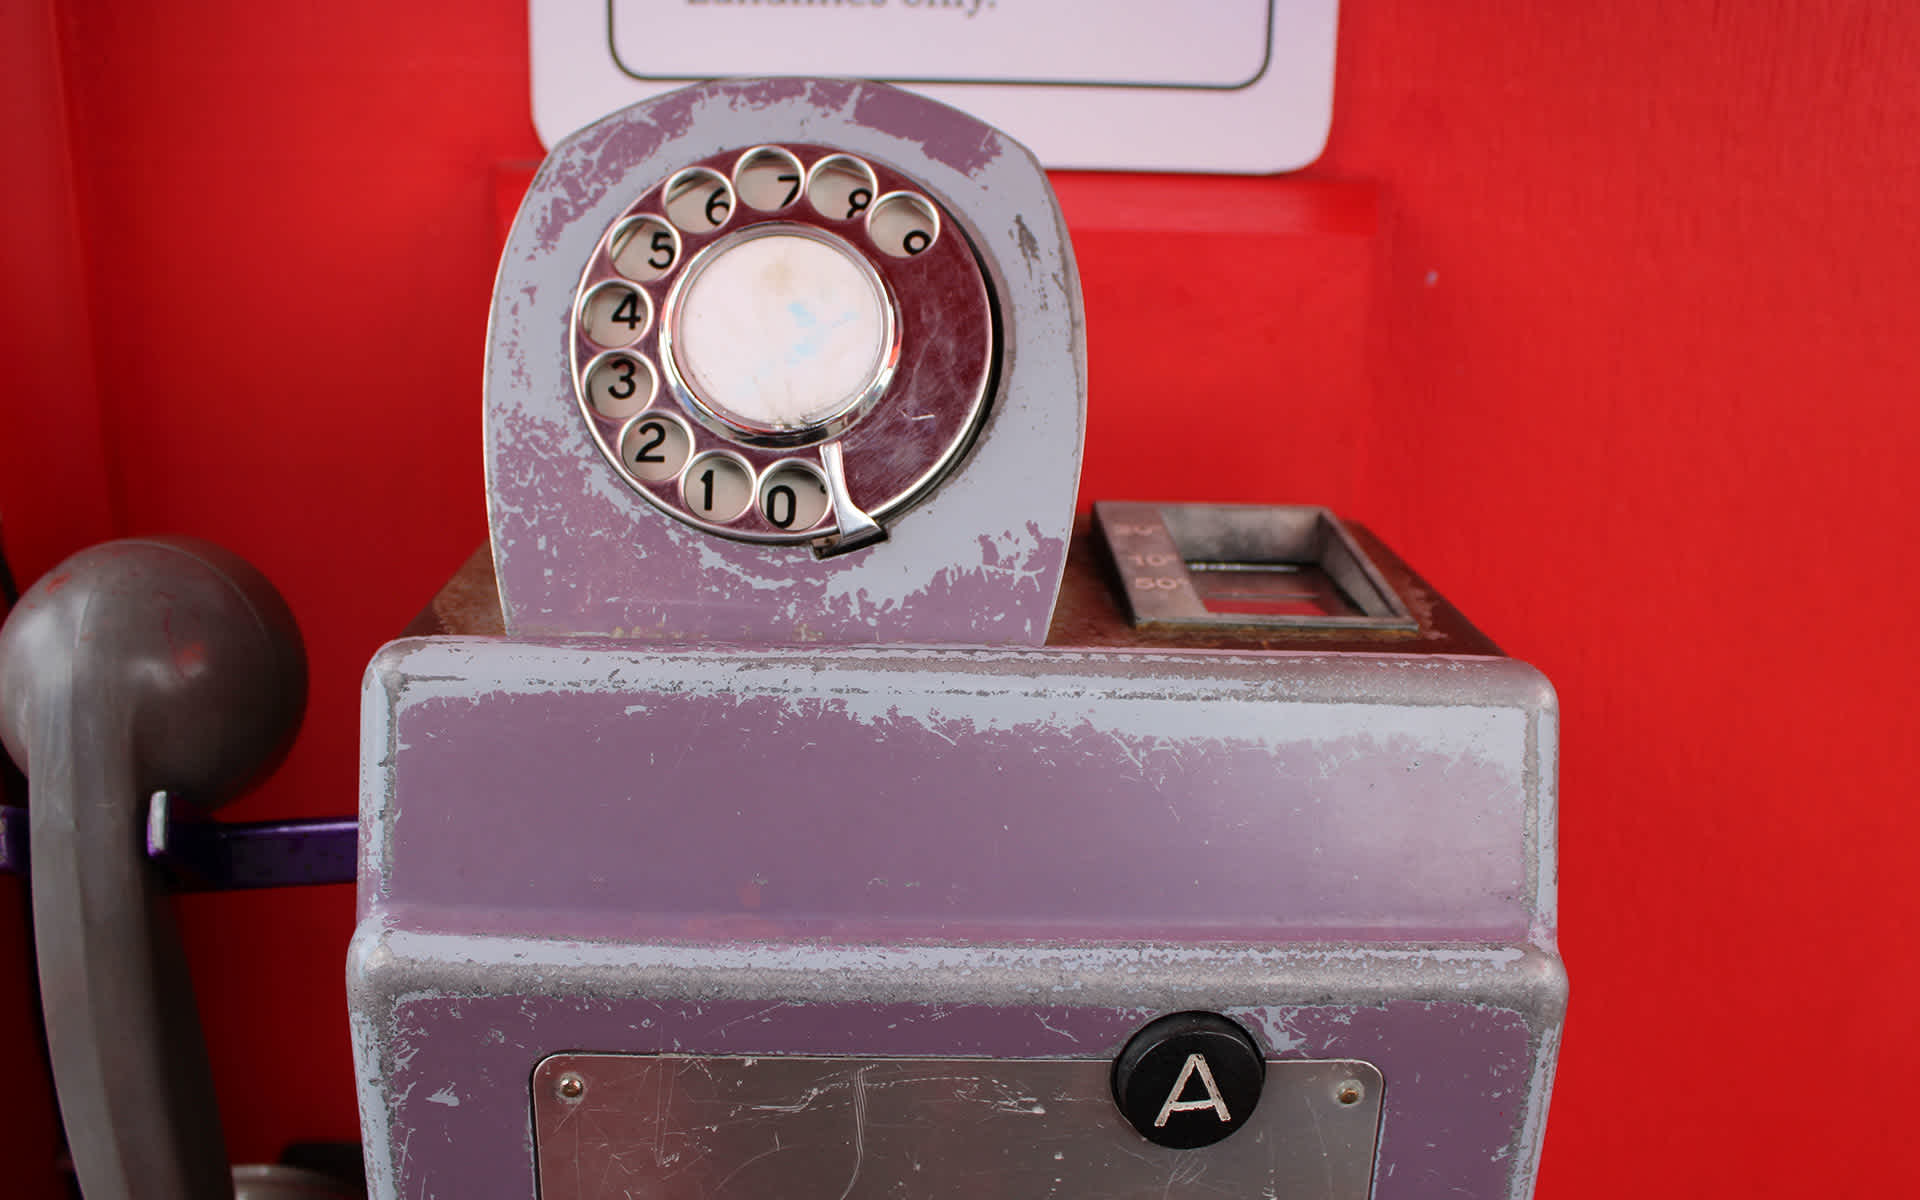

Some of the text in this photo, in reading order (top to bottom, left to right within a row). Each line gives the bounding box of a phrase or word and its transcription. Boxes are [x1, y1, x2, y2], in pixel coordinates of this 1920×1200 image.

[706, 186, 731, 226] 6
[777, 175, 801, 209] 7
[648, 232, 675, 269] 5
[611, 293, 641, 330] 4
[608, 358, 637, 400] 3
[635, 421, 666, 463] 2
[700, 469, 715, 511] 1
[766, 485, 797, 528] 0
[1154, 1053, 1232, 1127] A
